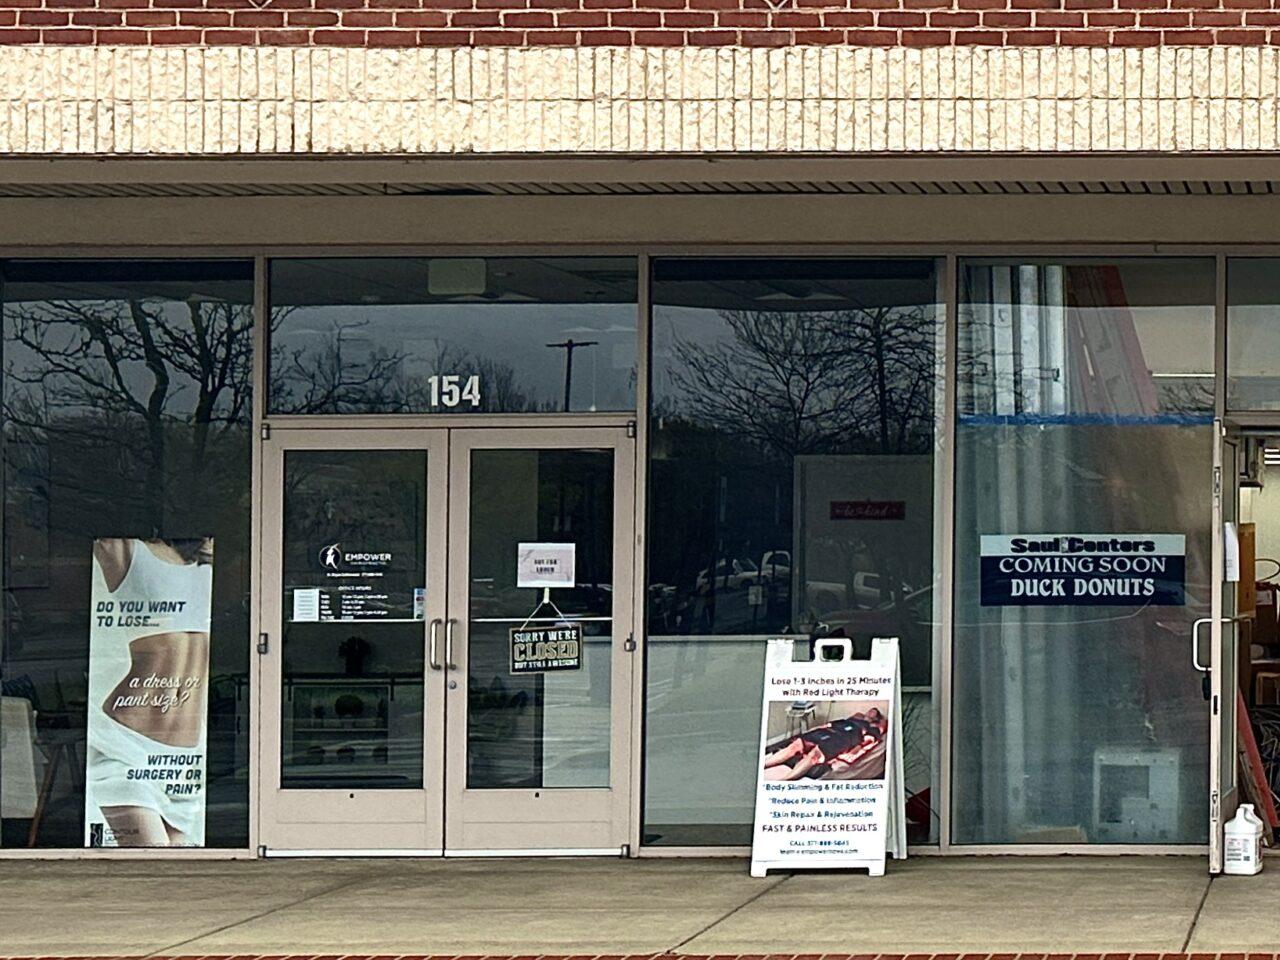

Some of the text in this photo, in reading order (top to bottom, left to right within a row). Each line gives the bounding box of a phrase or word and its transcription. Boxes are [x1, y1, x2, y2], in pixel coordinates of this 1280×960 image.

[427, 375, 480, 407] 154
[1011, 537, 1155, 553] Saul Centers
[344, 553, 392, 561] EMPOWER
[999, 556, 1166, 573] COMING SOON
[1011, 578, 1155, 596] DUCK DONUTS
[96, 601, 187, 613] DO YOU WANT
[97, 616, 114, 627] TO
[513, 632, 546, 643] SORRY
[513, 640, 579, 661] CLOSED
[129, 673, 200, 688] a dress or
[822, 688, 843, 697] Light
[846, 688, 879, 697] Therapy
[112, 690, 190, 713] pant size?
[147, 754, 203, 766] WITHOUT
[126, 769, 202, 780] SURGERY OR
[164, 784, 202, 795] PAIN?
[824, 811, 873, 819] Rejuvenation
[762, 823, 878, 832] FAST & PAINLESS RESULTS
